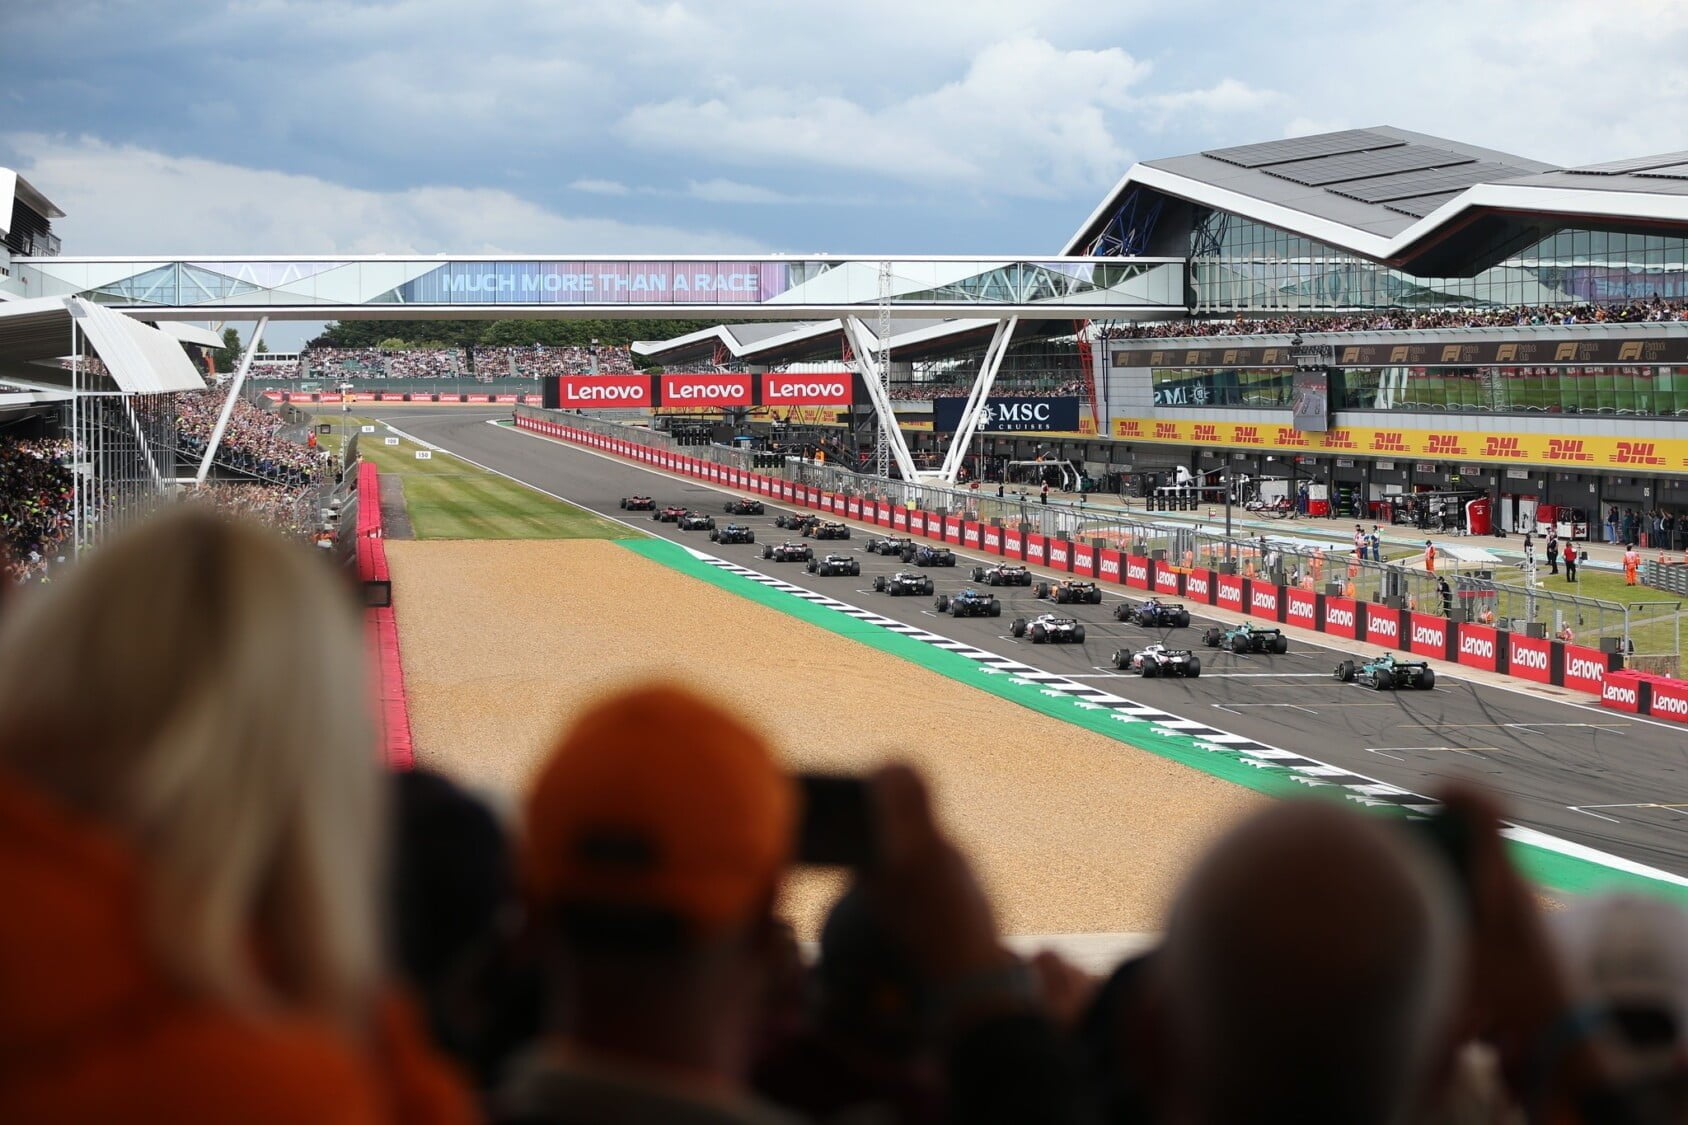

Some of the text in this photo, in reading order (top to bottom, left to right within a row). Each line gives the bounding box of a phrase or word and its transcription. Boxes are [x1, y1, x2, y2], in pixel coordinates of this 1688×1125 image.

[443, 274, 759, 291] MUCH MORE THAN A RACE
[568, 383, 643, 399] Lenovo
[669, 382, 744, 398] Lenovo
[770, 381, 844, 397] Lenovo
[999, 403, 1050, 421] MSC
[1193, 424, 1218, 441] DHL
[1234, 426, 1260, 443] DHL
[1325, 431, 1353, 448] DHL
[1374, 432, 1405, 451] DHL
[1428, 434, 1462, 454] DHL
[1486, 437, 1521, 457] DHL
[1549, 439, 1587, 461] DHL
[1616, 442, 1658, 465] DHL
[1006, 536, 1020, 551] Lenovo
[1028, 541, 1043, 557] Lenovo
[1051, 546, 1066, 562] Lenovo
[1075, 551, 1092, 568] Lenovo
[1101, 557, 1118, 574] Lenovo
[1128, 562, 1146, 580] Lenovo
[1156, 567, 1177, 587] Lenovo
[1187, 574, 1208, 594] Lenovo
[1218, 581, 1240, 602] Lenovo
[1252, 588, 1275, 609] Lenovo
[1289, 596, 1313, 618] Lenovo
[1327, 604, 1353, 626] Lenovo
[1368, 612, 1396, 636] Lenovo
[1413, 622, 1443, 646] Lenovo
[1461, 632, 1492, 658] Lenovo
[1512, 642, 1547, 669] Lenovo
[1566, 653, 1604, 681] Lenovo
[1603, 681, 1636, 704] Lenovo
[1653, 690, 1688, 715] Lenovo
